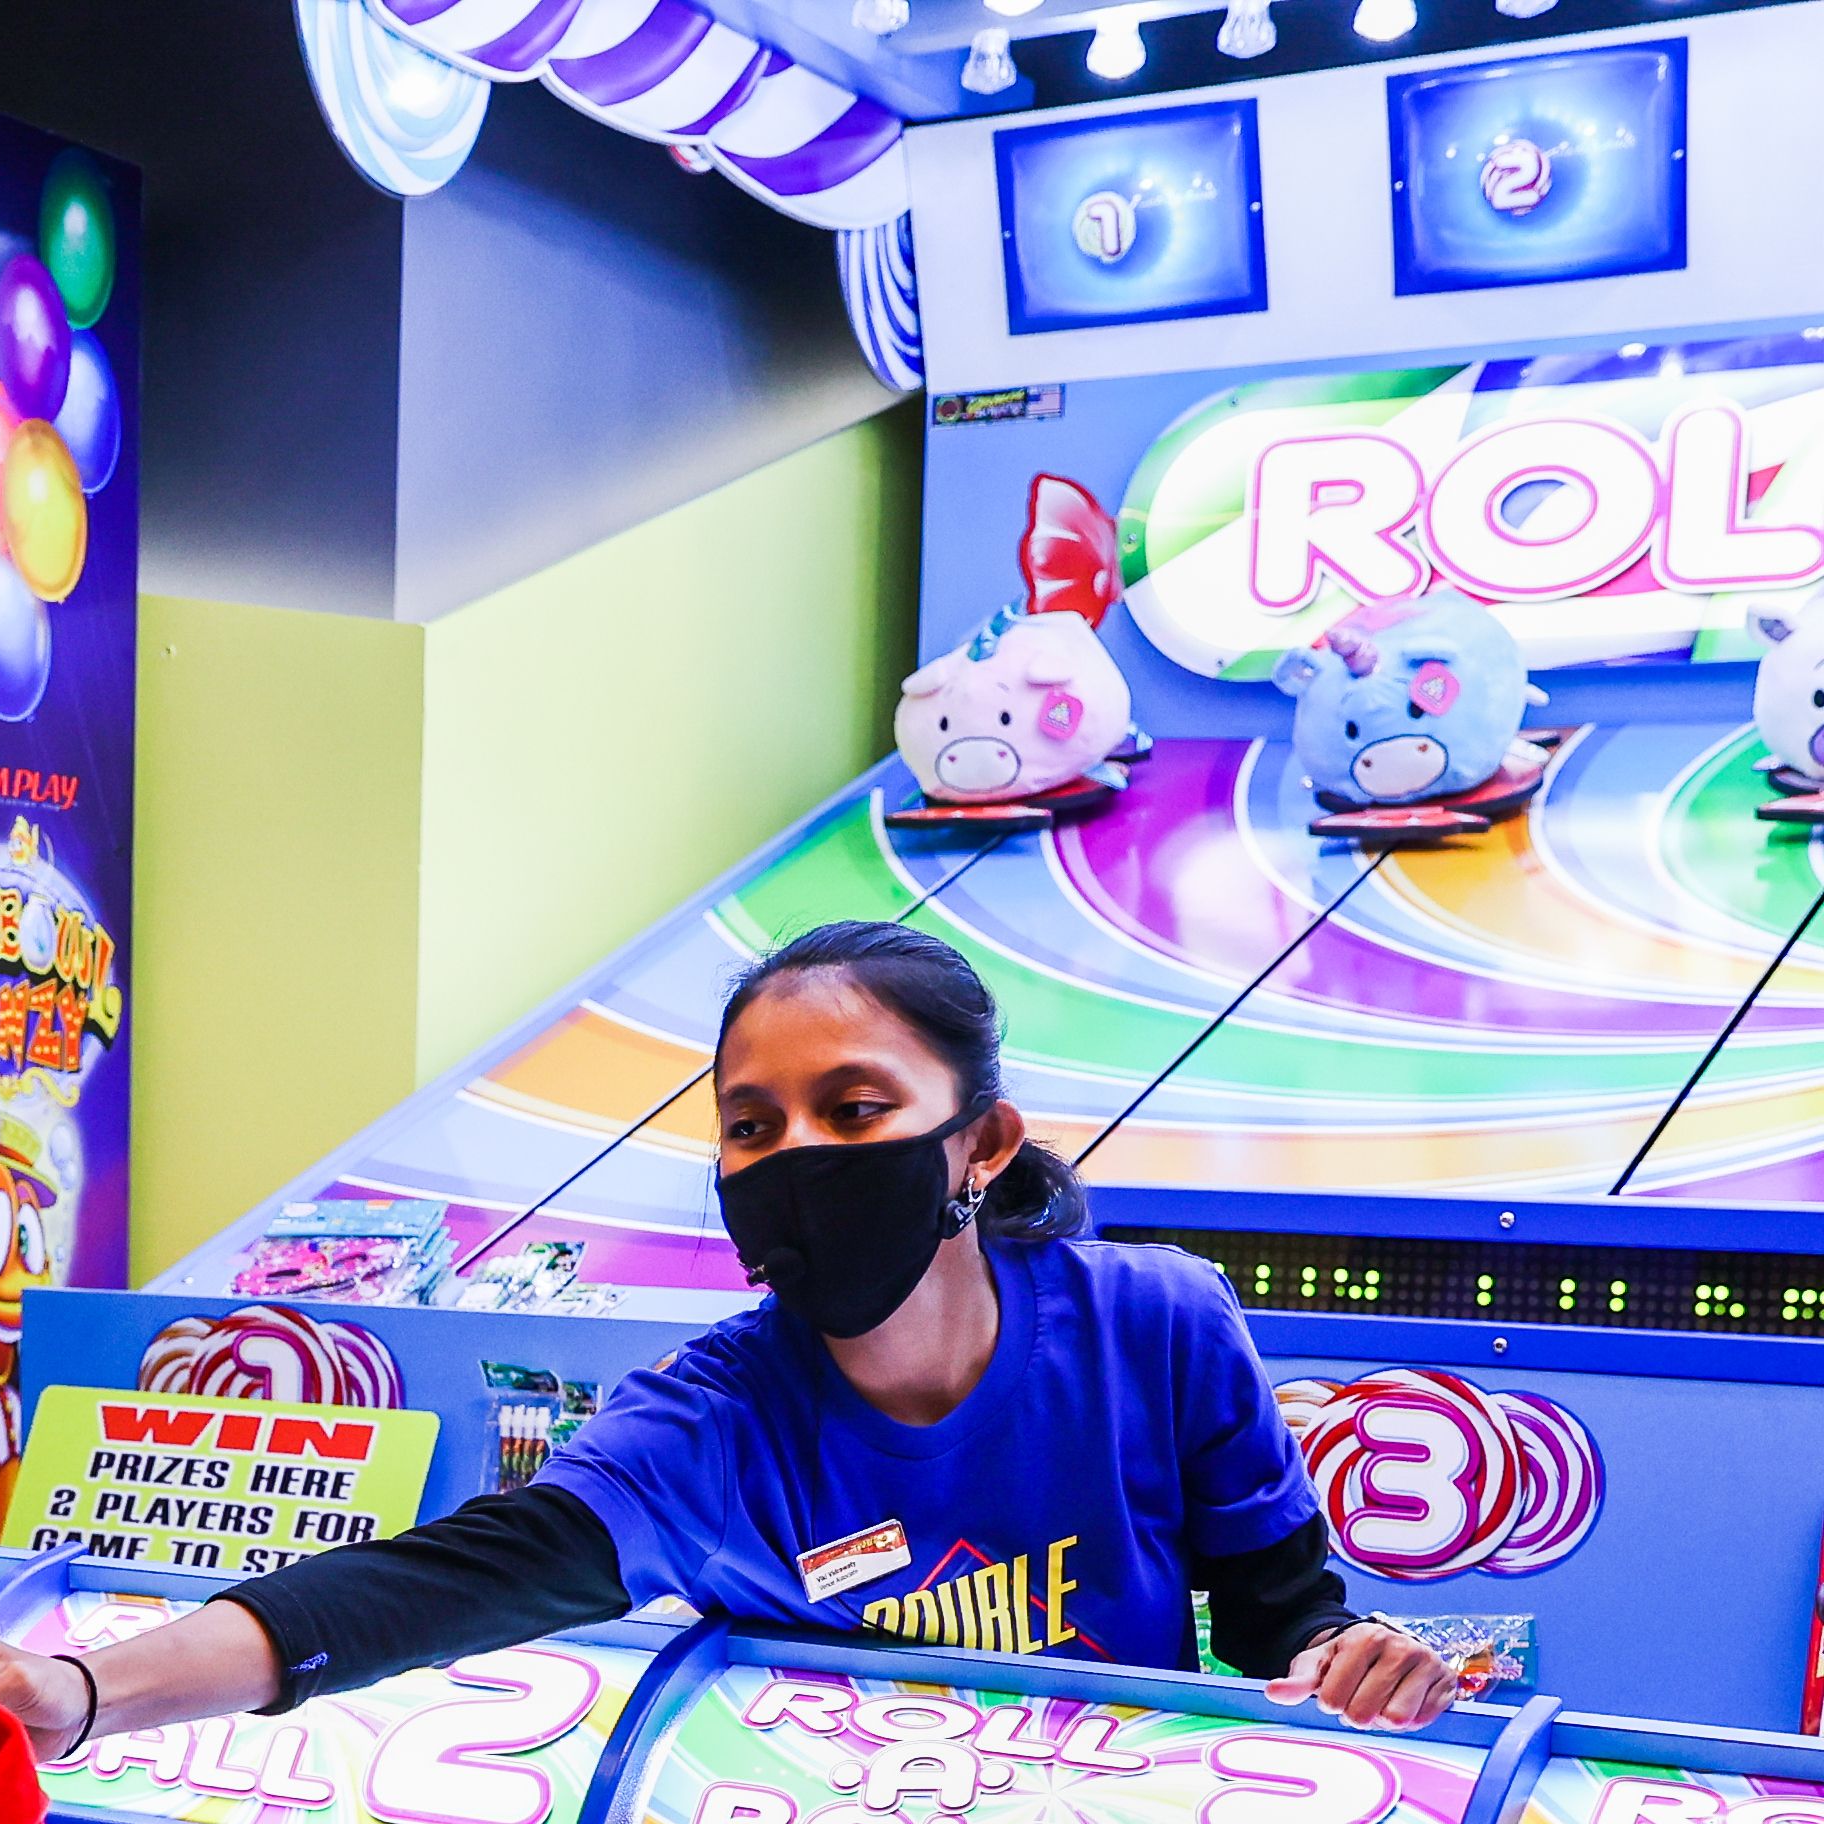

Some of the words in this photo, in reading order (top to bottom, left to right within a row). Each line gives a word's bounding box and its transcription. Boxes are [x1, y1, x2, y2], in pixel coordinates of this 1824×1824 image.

[1490, 141, 1543, 210] 2
[1085, 199, 1121, 257] 1
[1248, 406, 1824, 609] ROL
[100, 1404, 374, 1461] WIN
[88, 1451, 230, 1489] PRIZES
[249, 1465, 355, 1500] HERE
[1343, 1398, 1484, 1567] 3
[50, 1488, 77, 1516] 2
[95, 1493, 275, 1535] PLAYERS
[293, 1511, 376, 1542] FOR
[171, 1540, 221, 1568] TO
[862, 1535, 1079, 1656] DOUBLE
[38, 1713, 336, 1811] ALL
[740, 1679, 1154, 1776] ROLL
